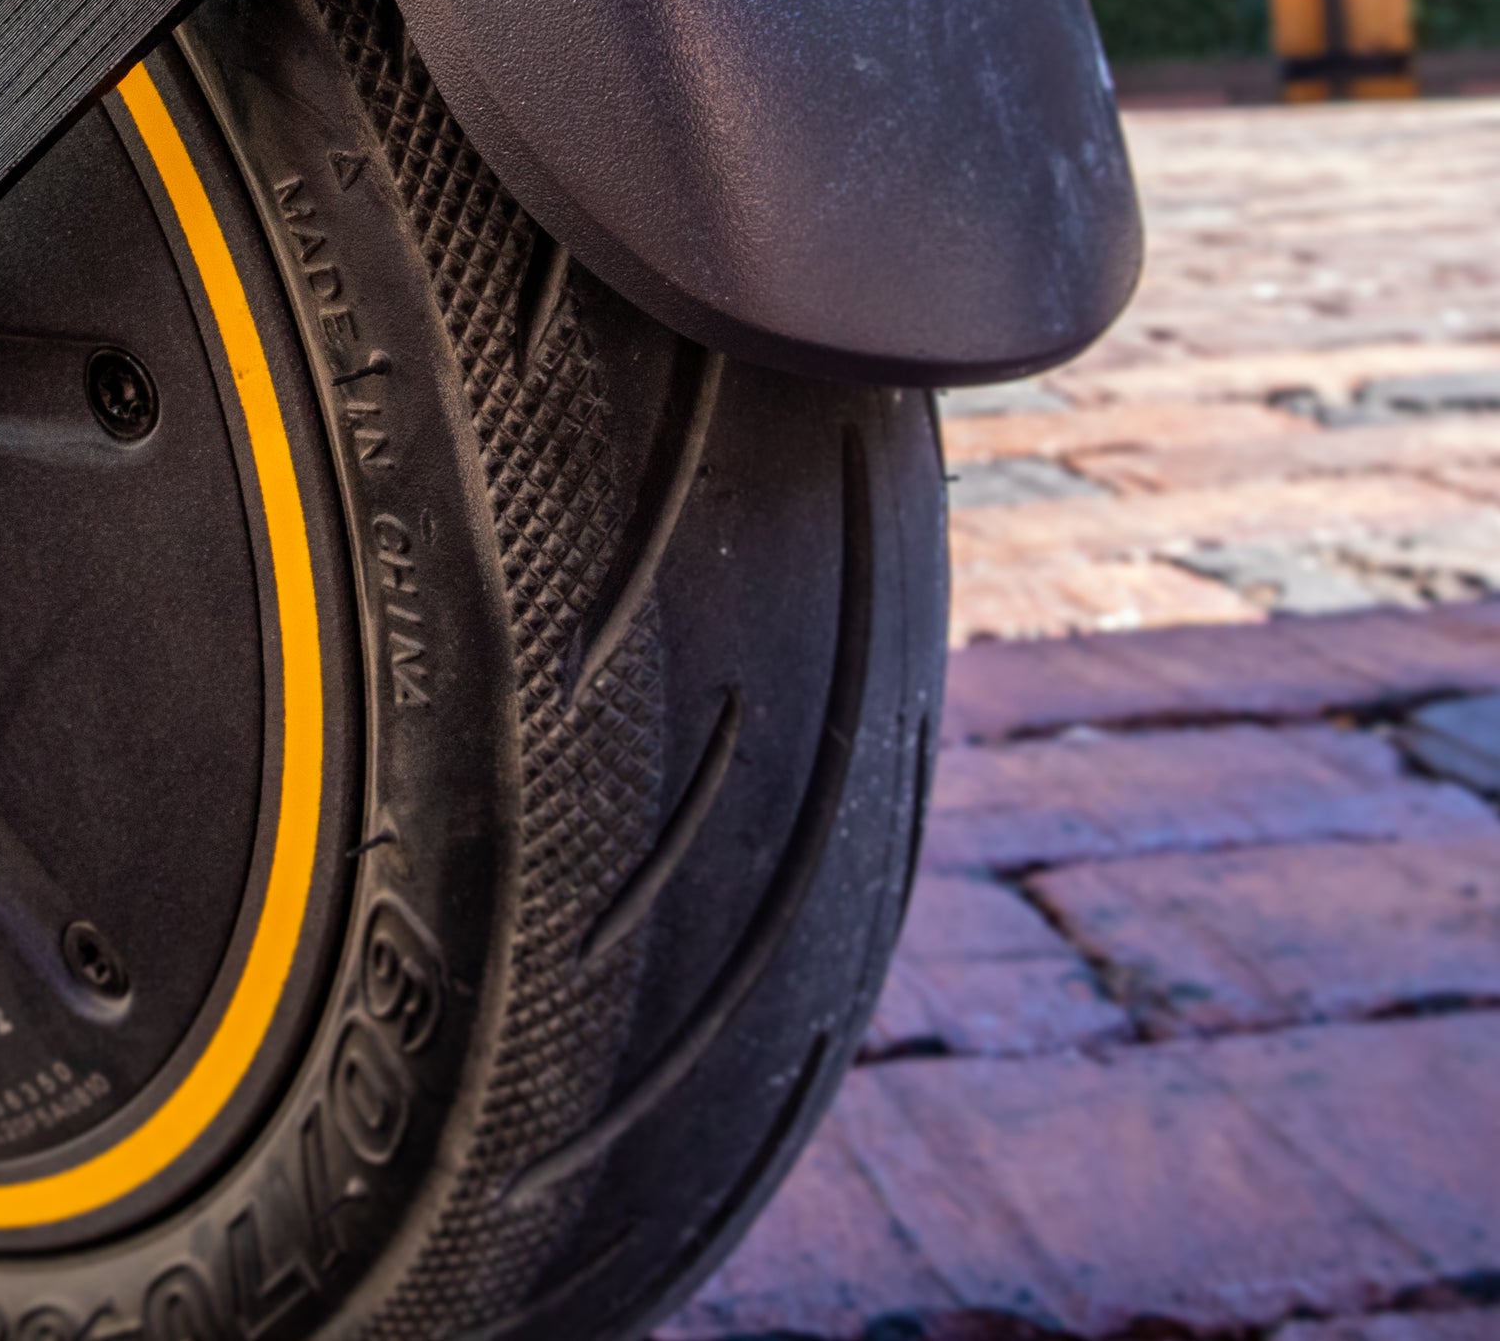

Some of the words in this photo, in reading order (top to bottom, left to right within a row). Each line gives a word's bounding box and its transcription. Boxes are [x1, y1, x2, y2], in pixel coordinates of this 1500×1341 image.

[272, 175, 360, 346] MADE
[344, 400, 395, 473] IN
[372, 512, 431, 711] CHINA
